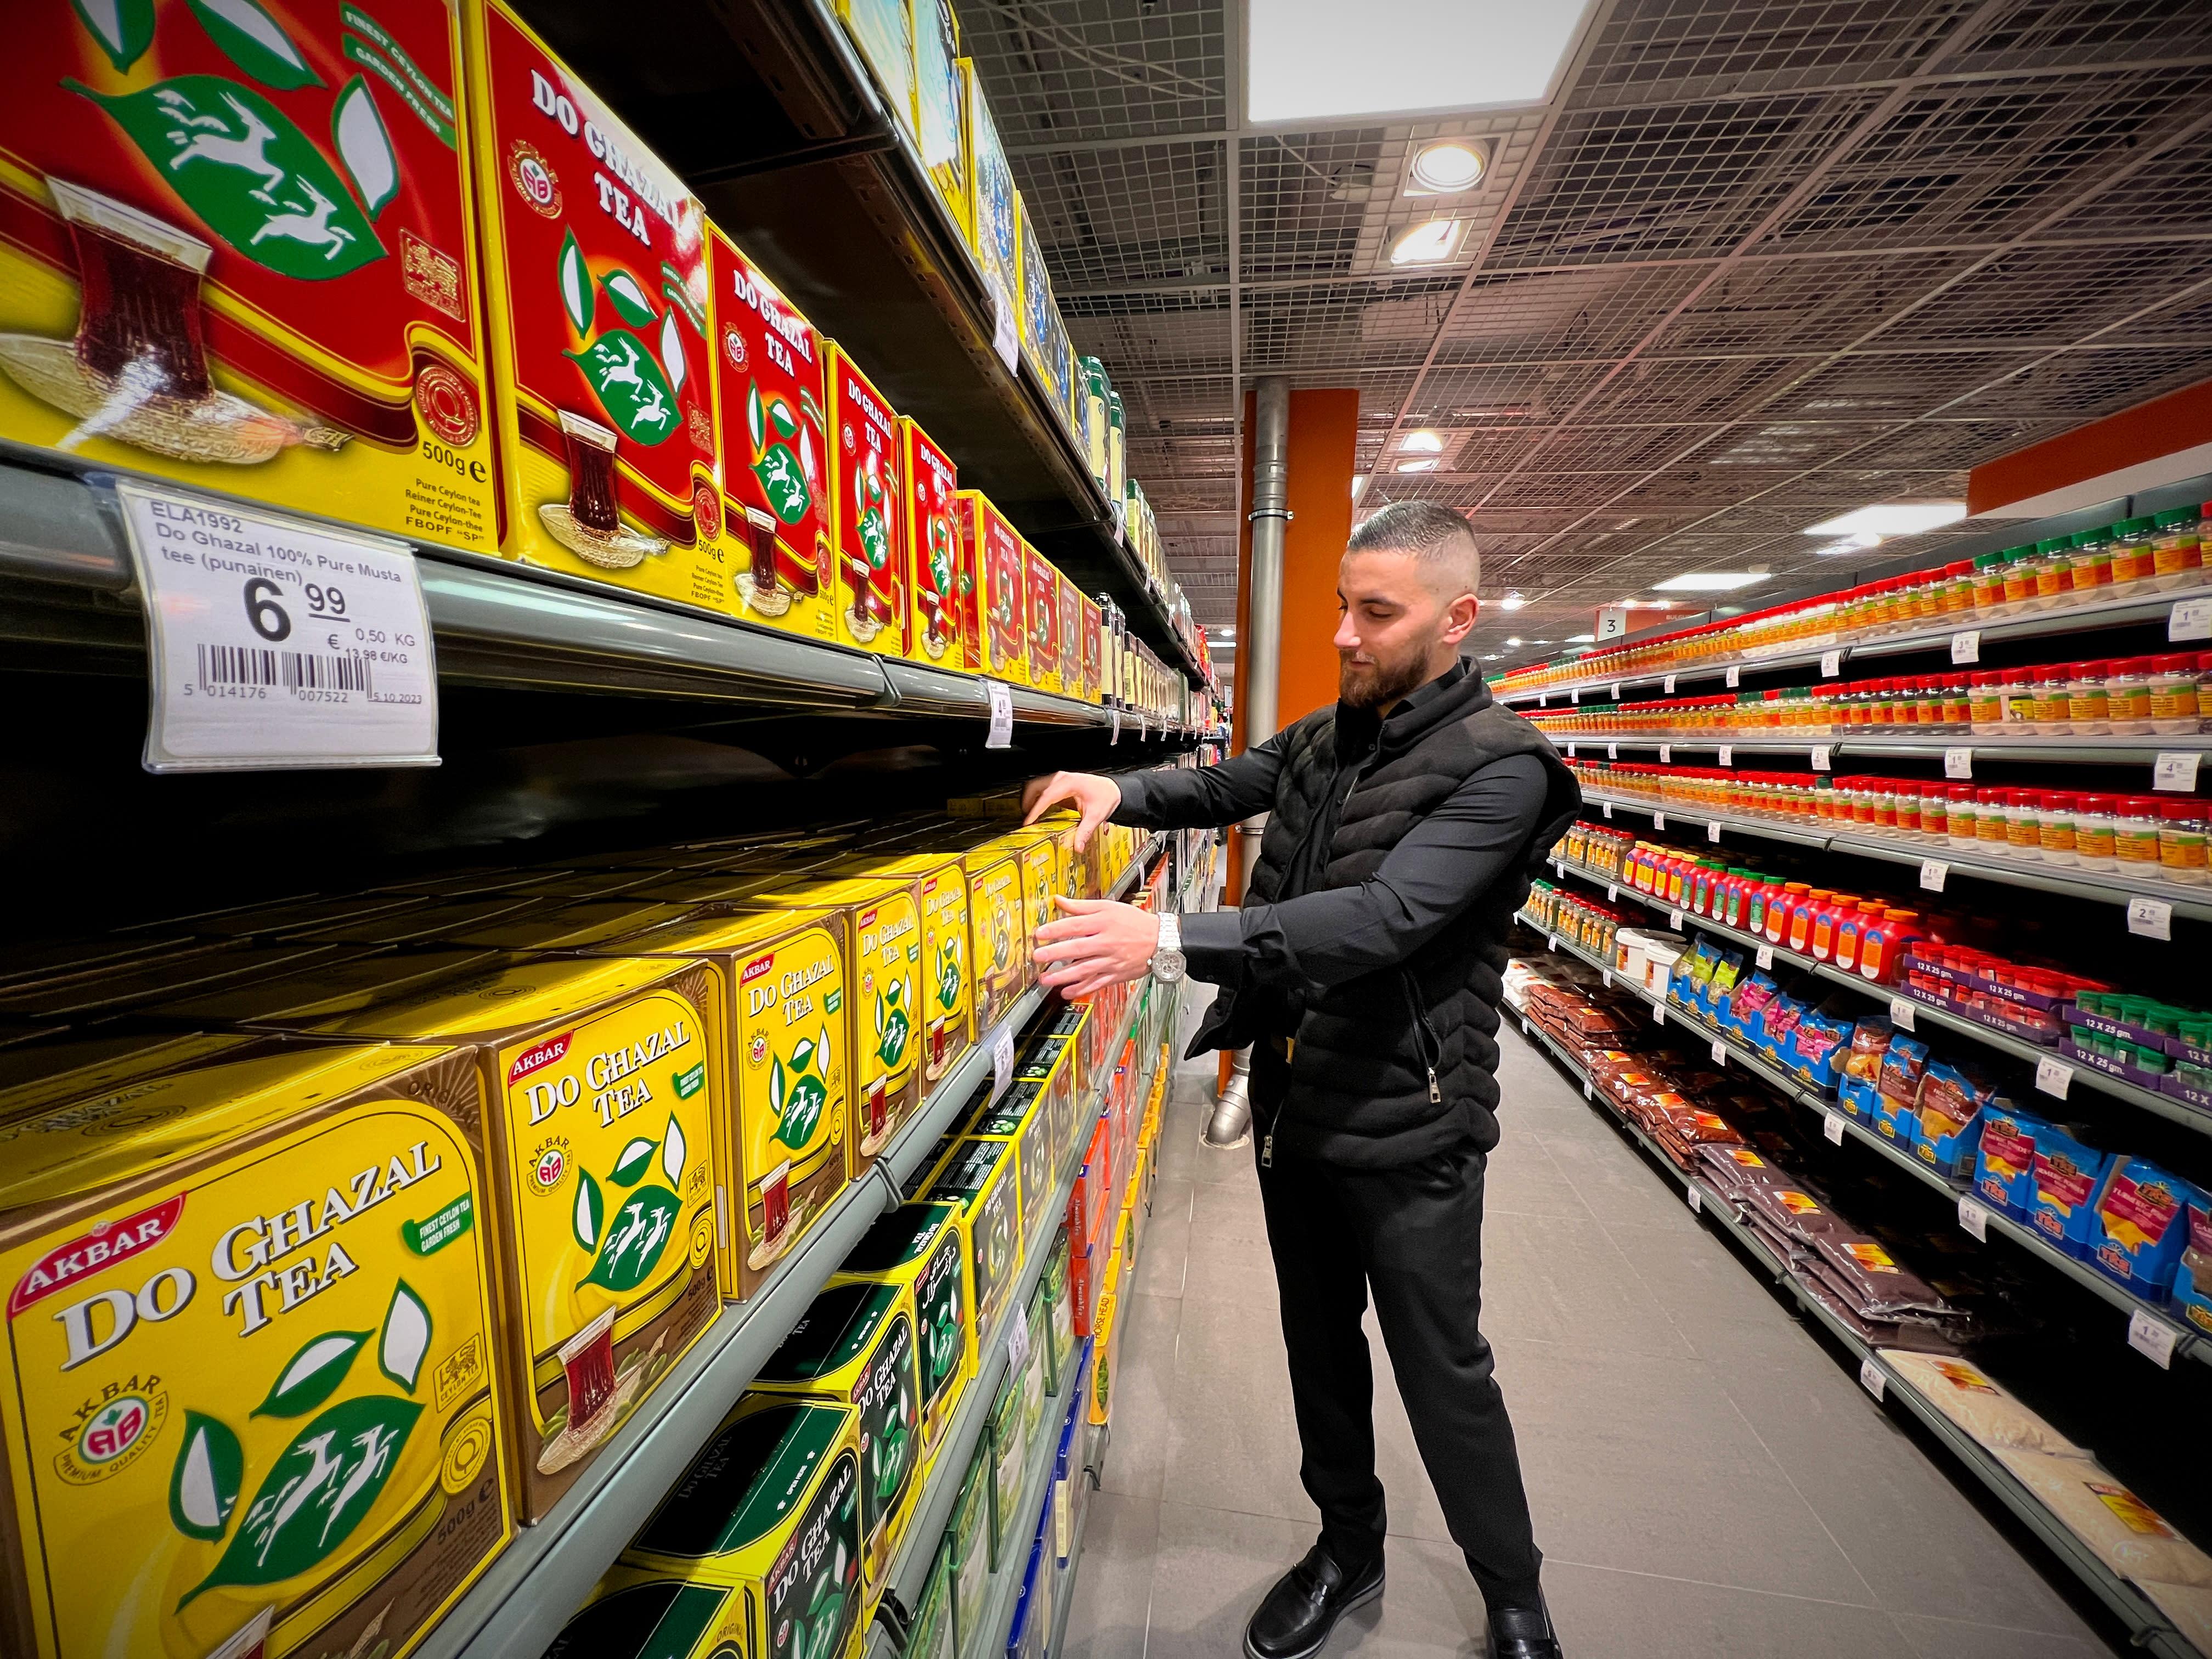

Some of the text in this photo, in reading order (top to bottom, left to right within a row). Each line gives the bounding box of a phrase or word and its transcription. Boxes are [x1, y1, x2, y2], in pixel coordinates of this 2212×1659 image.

[346, 11, 453, 119] FINEST CEYLON TEA
[356, 48, 404, 92] GARDEN
[531, 68, 580, 139] DO
[584, 120, 682, 235] GHAZAL
[594, 171, 651, 247] TEA
[733, 269, 758, 310] DO
[759, 295, 813, 364] GHAZAL
[764, 331, 795, 379] TEA
[848, 377, 892, 441] DO GHAZAL
[865, 421, 882, 455] TEA
[920, 443, 931, 465] DO
[422, 441, 465, 476] 500g
[405, 489, 482, 520] Reiner Ceylon-Tee
[416, 478, 481, 506] Pure Ceylon tea
[150, 501, 243, 533] ELA1992
[406, 516, 453, 535] FBOPF
[410, 504, 483, 533] Pure Ceylon-thee
[156, 522, 402, 583] Do Ghazal 100% Pure Musta
[161, 546, 303, 586] tee (punainen)
[244, 577, 347, 642] 6 99
[1607, 619, 1616, 632] 3
[327, 628, 415, 650] € 0,50 KG
[184, 684, 348, 703] 5 014176 007522
[862, 914, 914, 957] DO GHAZAL
[742, 960, 771, 980] AKBAR
[881, 945, 900, 967] TEA
[1917, 961, 1925, 970] 12
[1932, 966, 1940, 975] 25
[748, 955, 834, 1017] DO GHAZAL
[1989, 984, 1996, 993] 12
[2004, 988, 2012, 997] 25
[782, 995, 814, 1027] TEA
[2085, 1018, 2095, 1028] 12
[2097, 1022, 2103, 1030] X
[2105, 1024, 2115, 1034] 25
[513, 1042, 564, 1076] AKBAR
[524, 1074, 581, 1126] DO
[585, 1021, 691, 1091] GHAZAL
[2076, 1049, 2086, 1059] 12
[2087, 1053, 2095, 1063] X
[2096, 1057, 2108, 1068] 25
[2187, 1050, 2210, 1064] 12 X
[592, 1078, 653, 1128] TEA
[2185, 1090, 2209, 1105] 12 X
[529, 1135, 569, 1168] AKBAR
[420, 1198, 470, 1239] FINEST CEYLON TEA
[421, 1218, 460, 1252] GARDEN FRESH
[25, 1218, 163, 1295] AKBAR
[52, 1141, 442, 1372] DO GHAZAL
[222, 1242, 359, 1339] TEA
[1101, 1297, 1109, 1316] HEAD
[874, 1325, 907, 1391] GHAZAL
[877, 1371, 896, 1410] TEA
[59, 1374, 162, 1443] AKBAR
[61, 1397, 164, 1480] PREMIUM QUALITY TEA
[705, 1456, 730, 1479] TEA
[774, 1464, 851, 1614] DO GHAZAL
[803, 1528, 831, 1584] TEA
